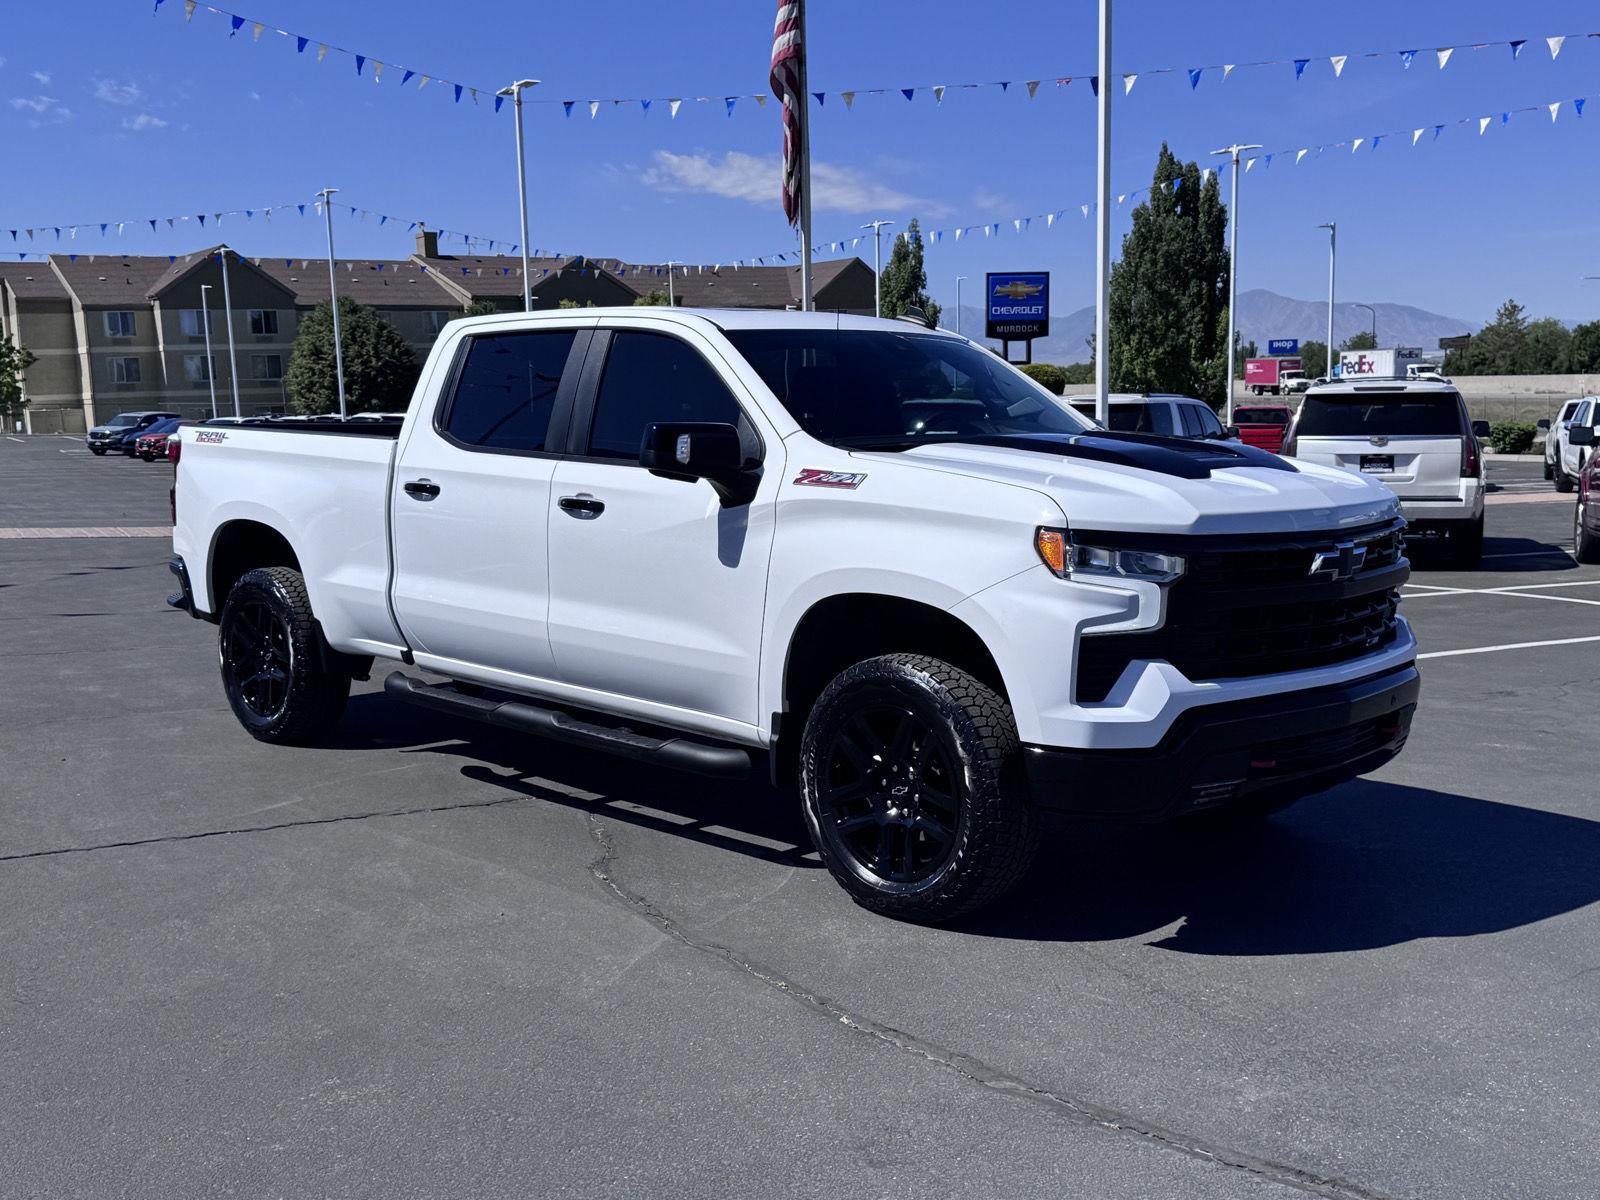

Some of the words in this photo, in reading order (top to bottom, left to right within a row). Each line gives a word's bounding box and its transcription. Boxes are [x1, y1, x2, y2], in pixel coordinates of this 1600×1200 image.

[992, 305, 1043, 315] CHEVROLET
[996, 324, 1039, 333] MURDOCK
[1397, 350, 1419, 359] FedEx
[1341, 354, 1374, 375] FedEx
[195, 431, 229, 440] TRAIL
